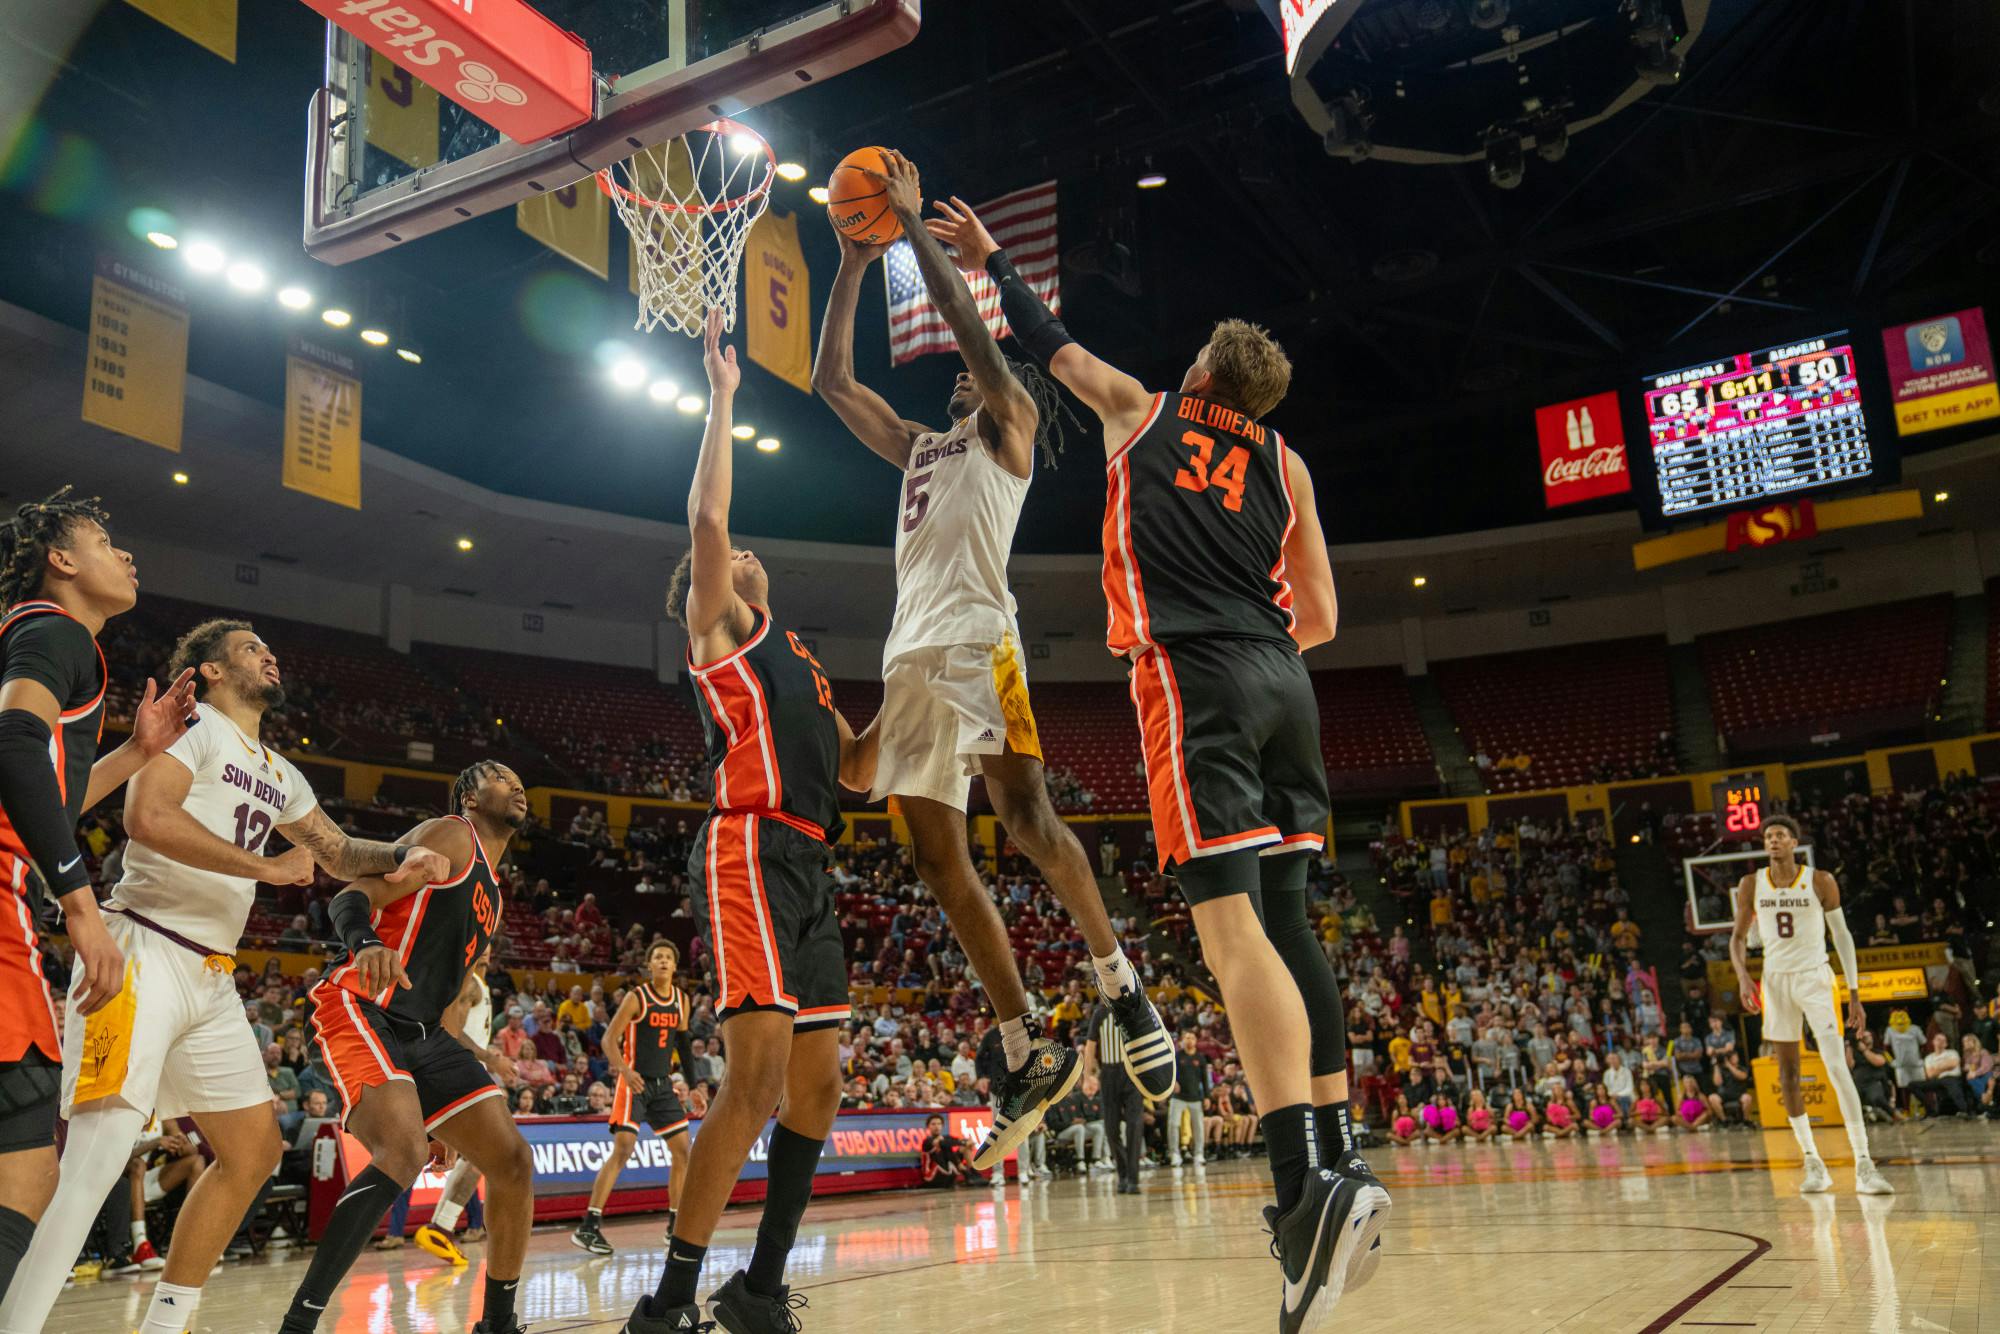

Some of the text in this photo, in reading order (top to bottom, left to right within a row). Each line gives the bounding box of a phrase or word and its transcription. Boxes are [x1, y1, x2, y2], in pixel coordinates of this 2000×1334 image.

[770, 276, 788, 329] 5
[1799, 357, 1838, 386] 50
[1925, 352, 1952, 367] NOW
[1720, 372, 1772, 400] 6:11
[1661, 388, 1699, 417] 65
[1902, 396, 1994, 424] GET THE APP
[1177, 396, 1266, 446] BILODEAU
[915, 438, 968, 469] DEVILS
[1174, 430, 1251, 513] 34
[903, 470, 934, 532] 5
[221, 763, 287, 813] SUN DEVILS
[233, 802, 272, 852] 12
[1726, 802, 1761, 832] 20
[472, 881, 495, 937] OSU
[1760, 897, 1810, 908] SUN DEVILS
[1775, 911, 1794, 938] 8
[650, 1011, 679, 1028] OSU
[659, 1028, 668, 1048] 2
[530, 1141, 615, 1175] WATCH
